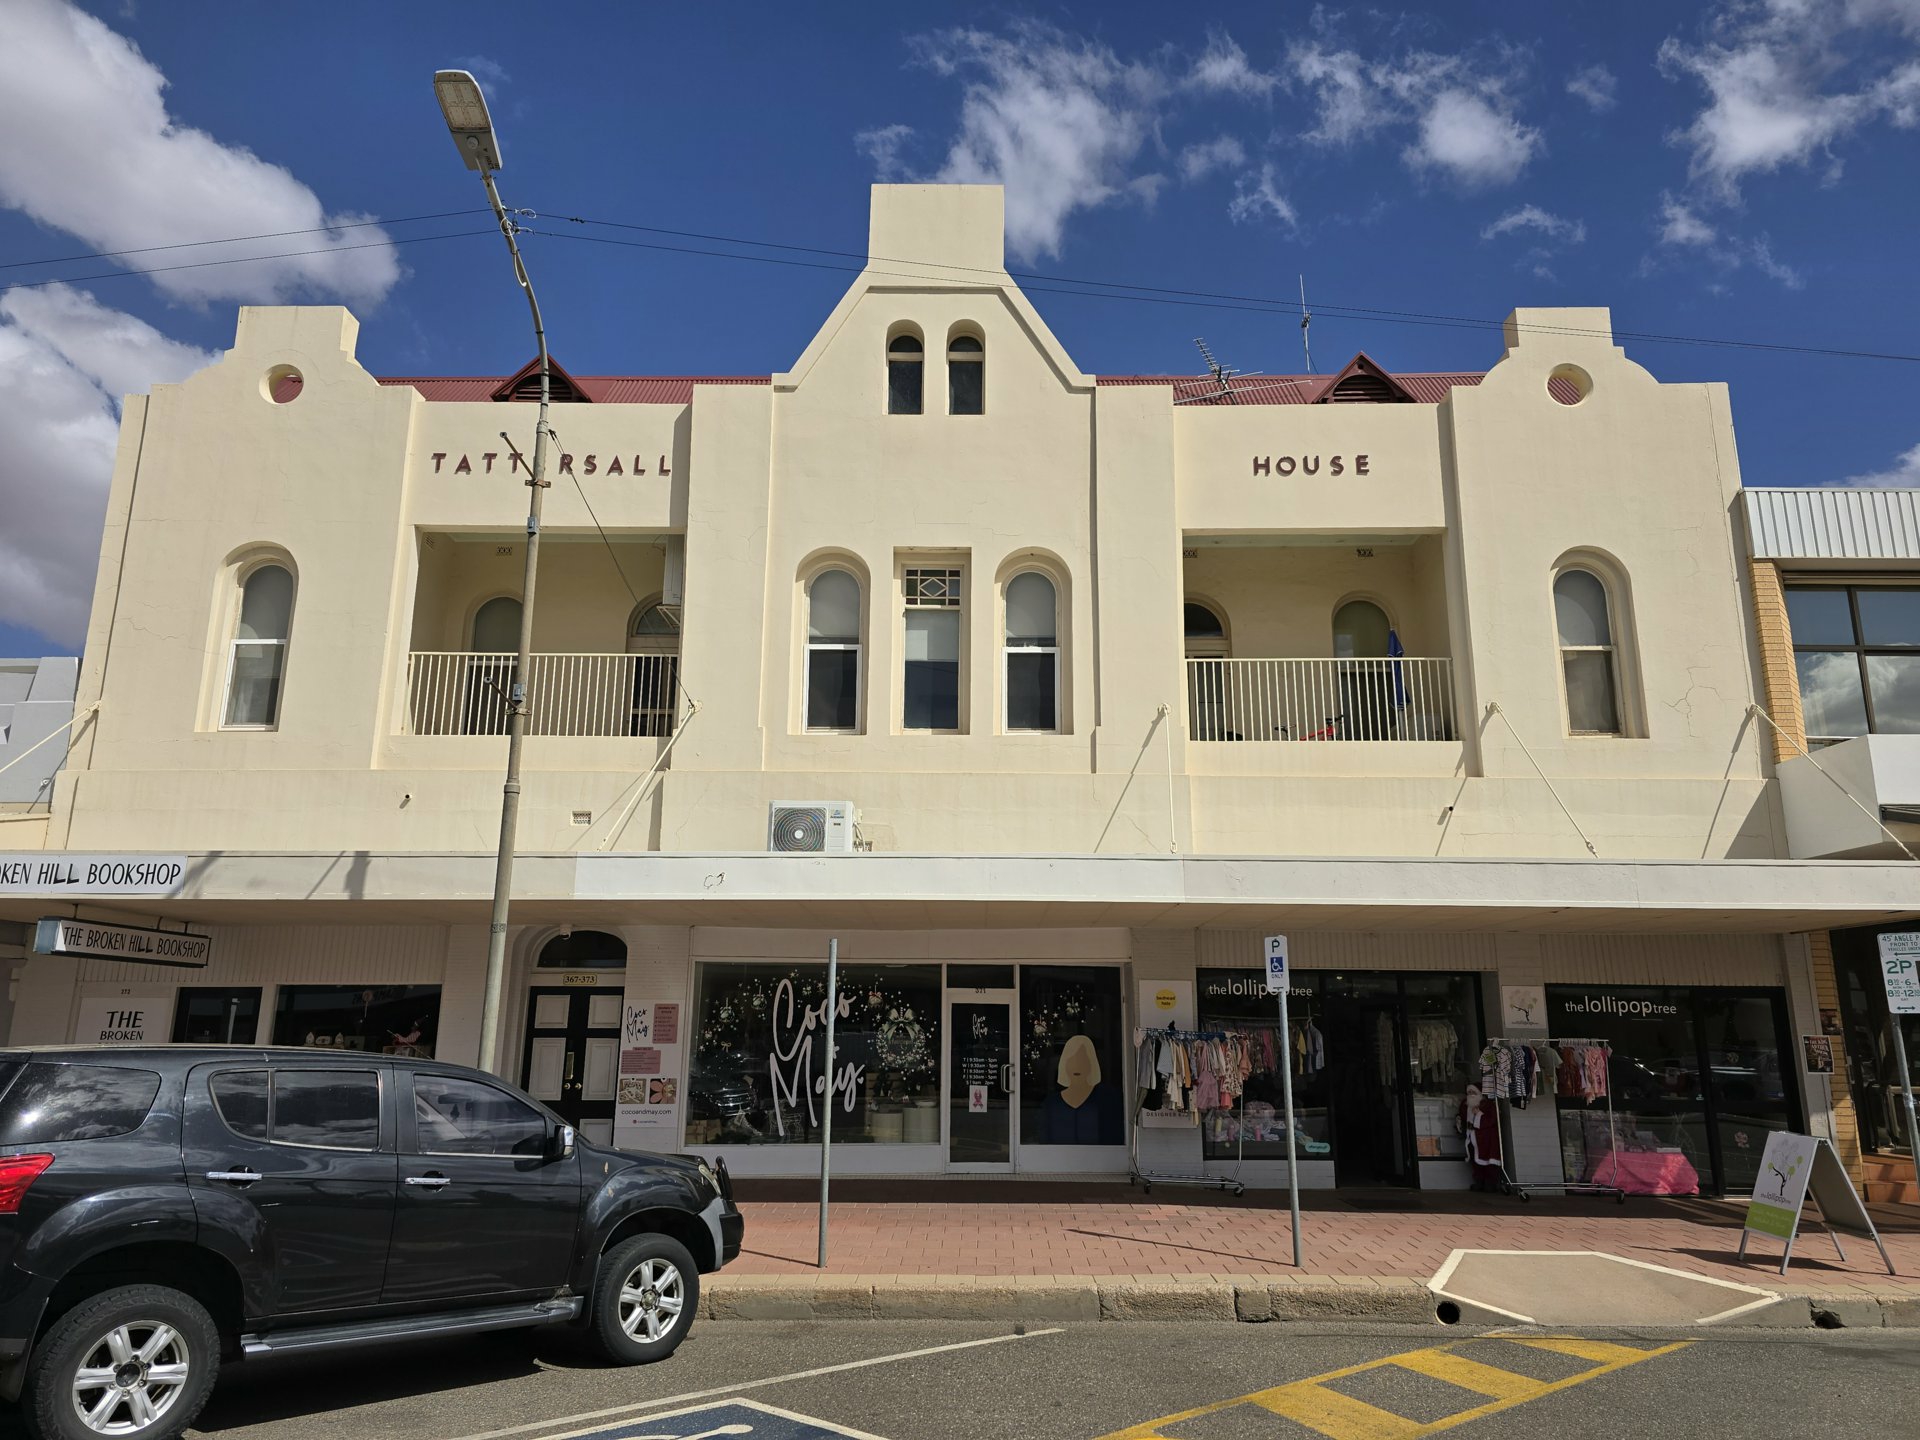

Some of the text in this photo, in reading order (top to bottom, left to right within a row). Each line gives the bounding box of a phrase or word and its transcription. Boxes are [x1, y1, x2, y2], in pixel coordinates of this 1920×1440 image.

[431, 452, 1370, 476] TATTRSALL HOUSE
[0, 863, 181, 886] KEN HILL BOOKSHOP
[64, 926, 206, 958] THE BROKEN HILL BOOKSHOP
[1271, 939, 1280, 952] P
[1895, 934, 1913, 942] ANGLE
[1886, 960, 1912, 974] 2P
[564, 975, 595, 984] 367-373
[1209, 983, 1227, 995] the
[1291, 987, 1313, 997] tree
[1565, 995, 1677, 1017] the lollipop tree
[106, 1010, 145, 1028] THE
[626, 1006, 647, 1026] Coco
[773, 978, 857, 1062] Coco
[99, 1030, 144, 1041] BROKEN
[626, 1021, 650, 1043] May
[621, 1107, 672, 1117] cocoandmay.com
